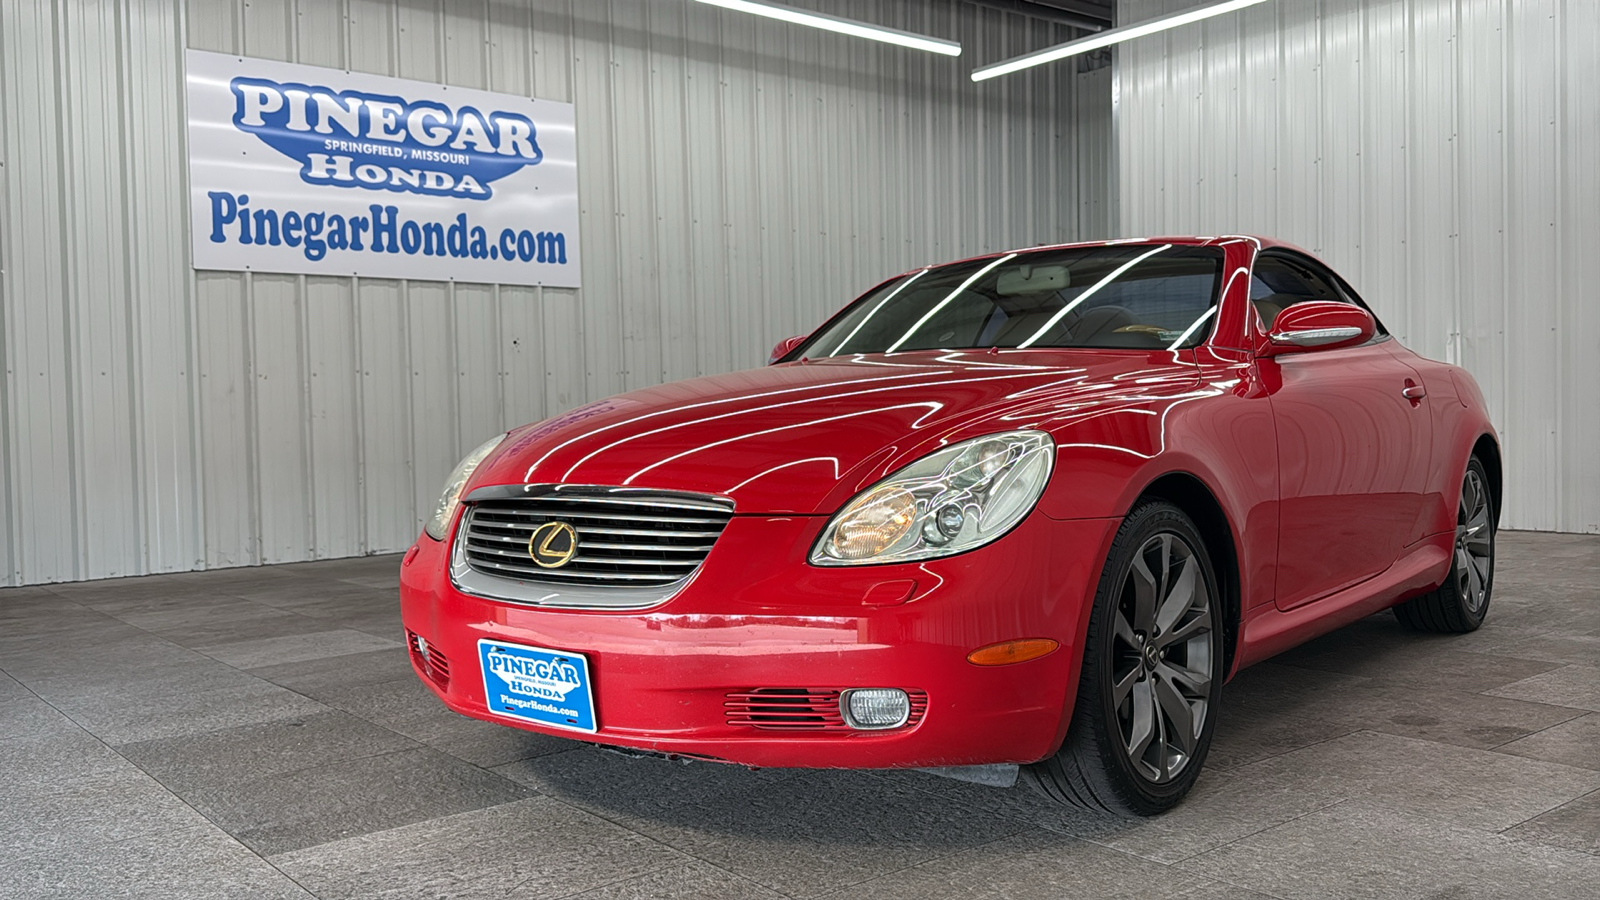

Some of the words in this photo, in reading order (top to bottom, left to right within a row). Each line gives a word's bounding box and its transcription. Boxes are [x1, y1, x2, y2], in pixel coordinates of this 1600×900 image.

[236, 84, 537, 160] PINEGAR
[324, 138, 408, 161] SPRINGFIELD,
[411, 148, 470, 165] MISSOURI
[207, 190, 568, 264] PinegarHonda.com
[490, 655, 579, 685] PINEGAR
[500, 694, 579, 717] PinegarHonda.com
